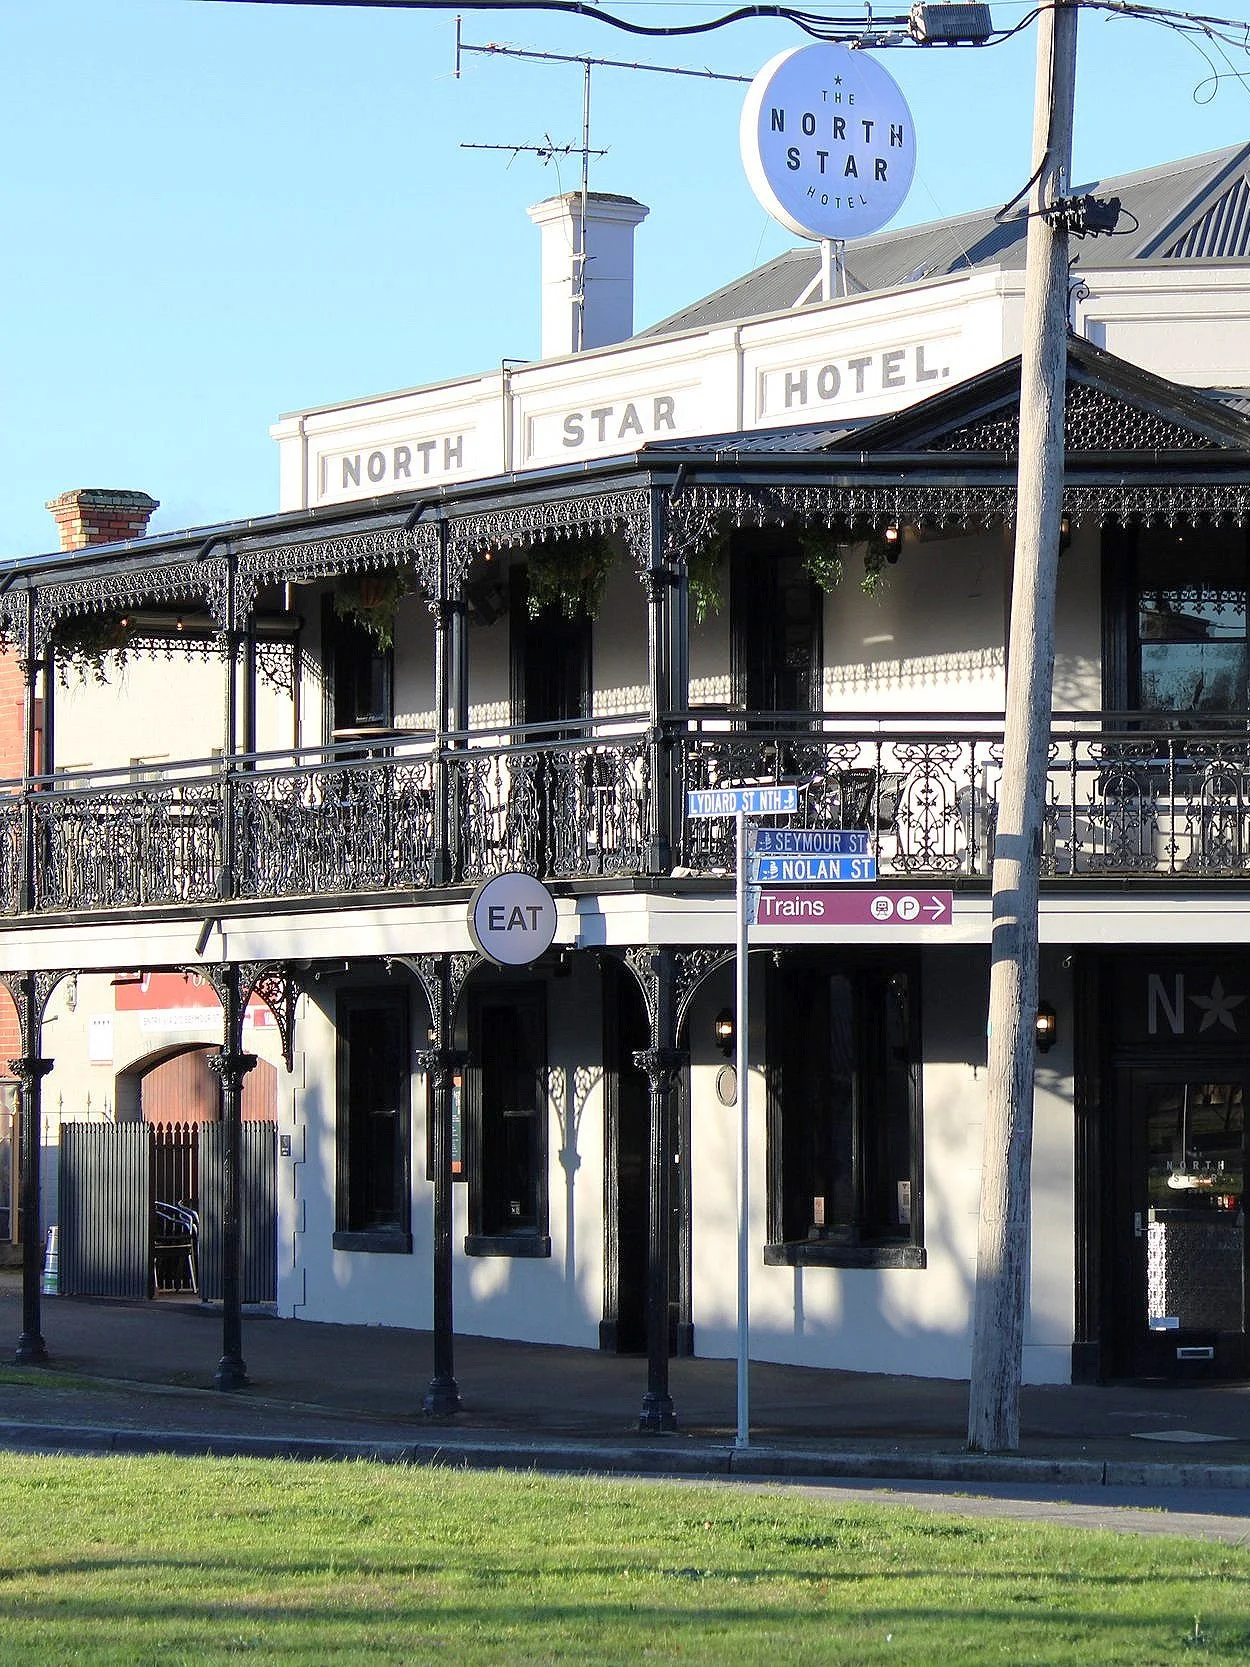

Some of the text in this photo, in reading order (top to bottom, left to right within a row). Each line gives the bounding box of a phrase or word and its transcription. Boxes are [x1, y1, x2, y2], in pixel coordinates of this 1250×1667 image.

[821, 89, 855, 106] THE
[771, 107, 903, 148] NORTH
[786, 146, 888, 182] STAR
[806, 185, 868, 209] HOTEL
[342, 345, 950, 489] NORTH STAR HOTEL.
[690, 789, 782, 814] LYDIARD ST NTH
[774, 831, 866, 853] SEYMOUR ST
[782, 858, 872, 881] NOLAN ST
[760, 895, 826, 917] Trains
[487, 905, 544, 932] EAT
[1147, 972, 1186, 1035] N
[1166, 1159, 1225, 1171] NORTH
